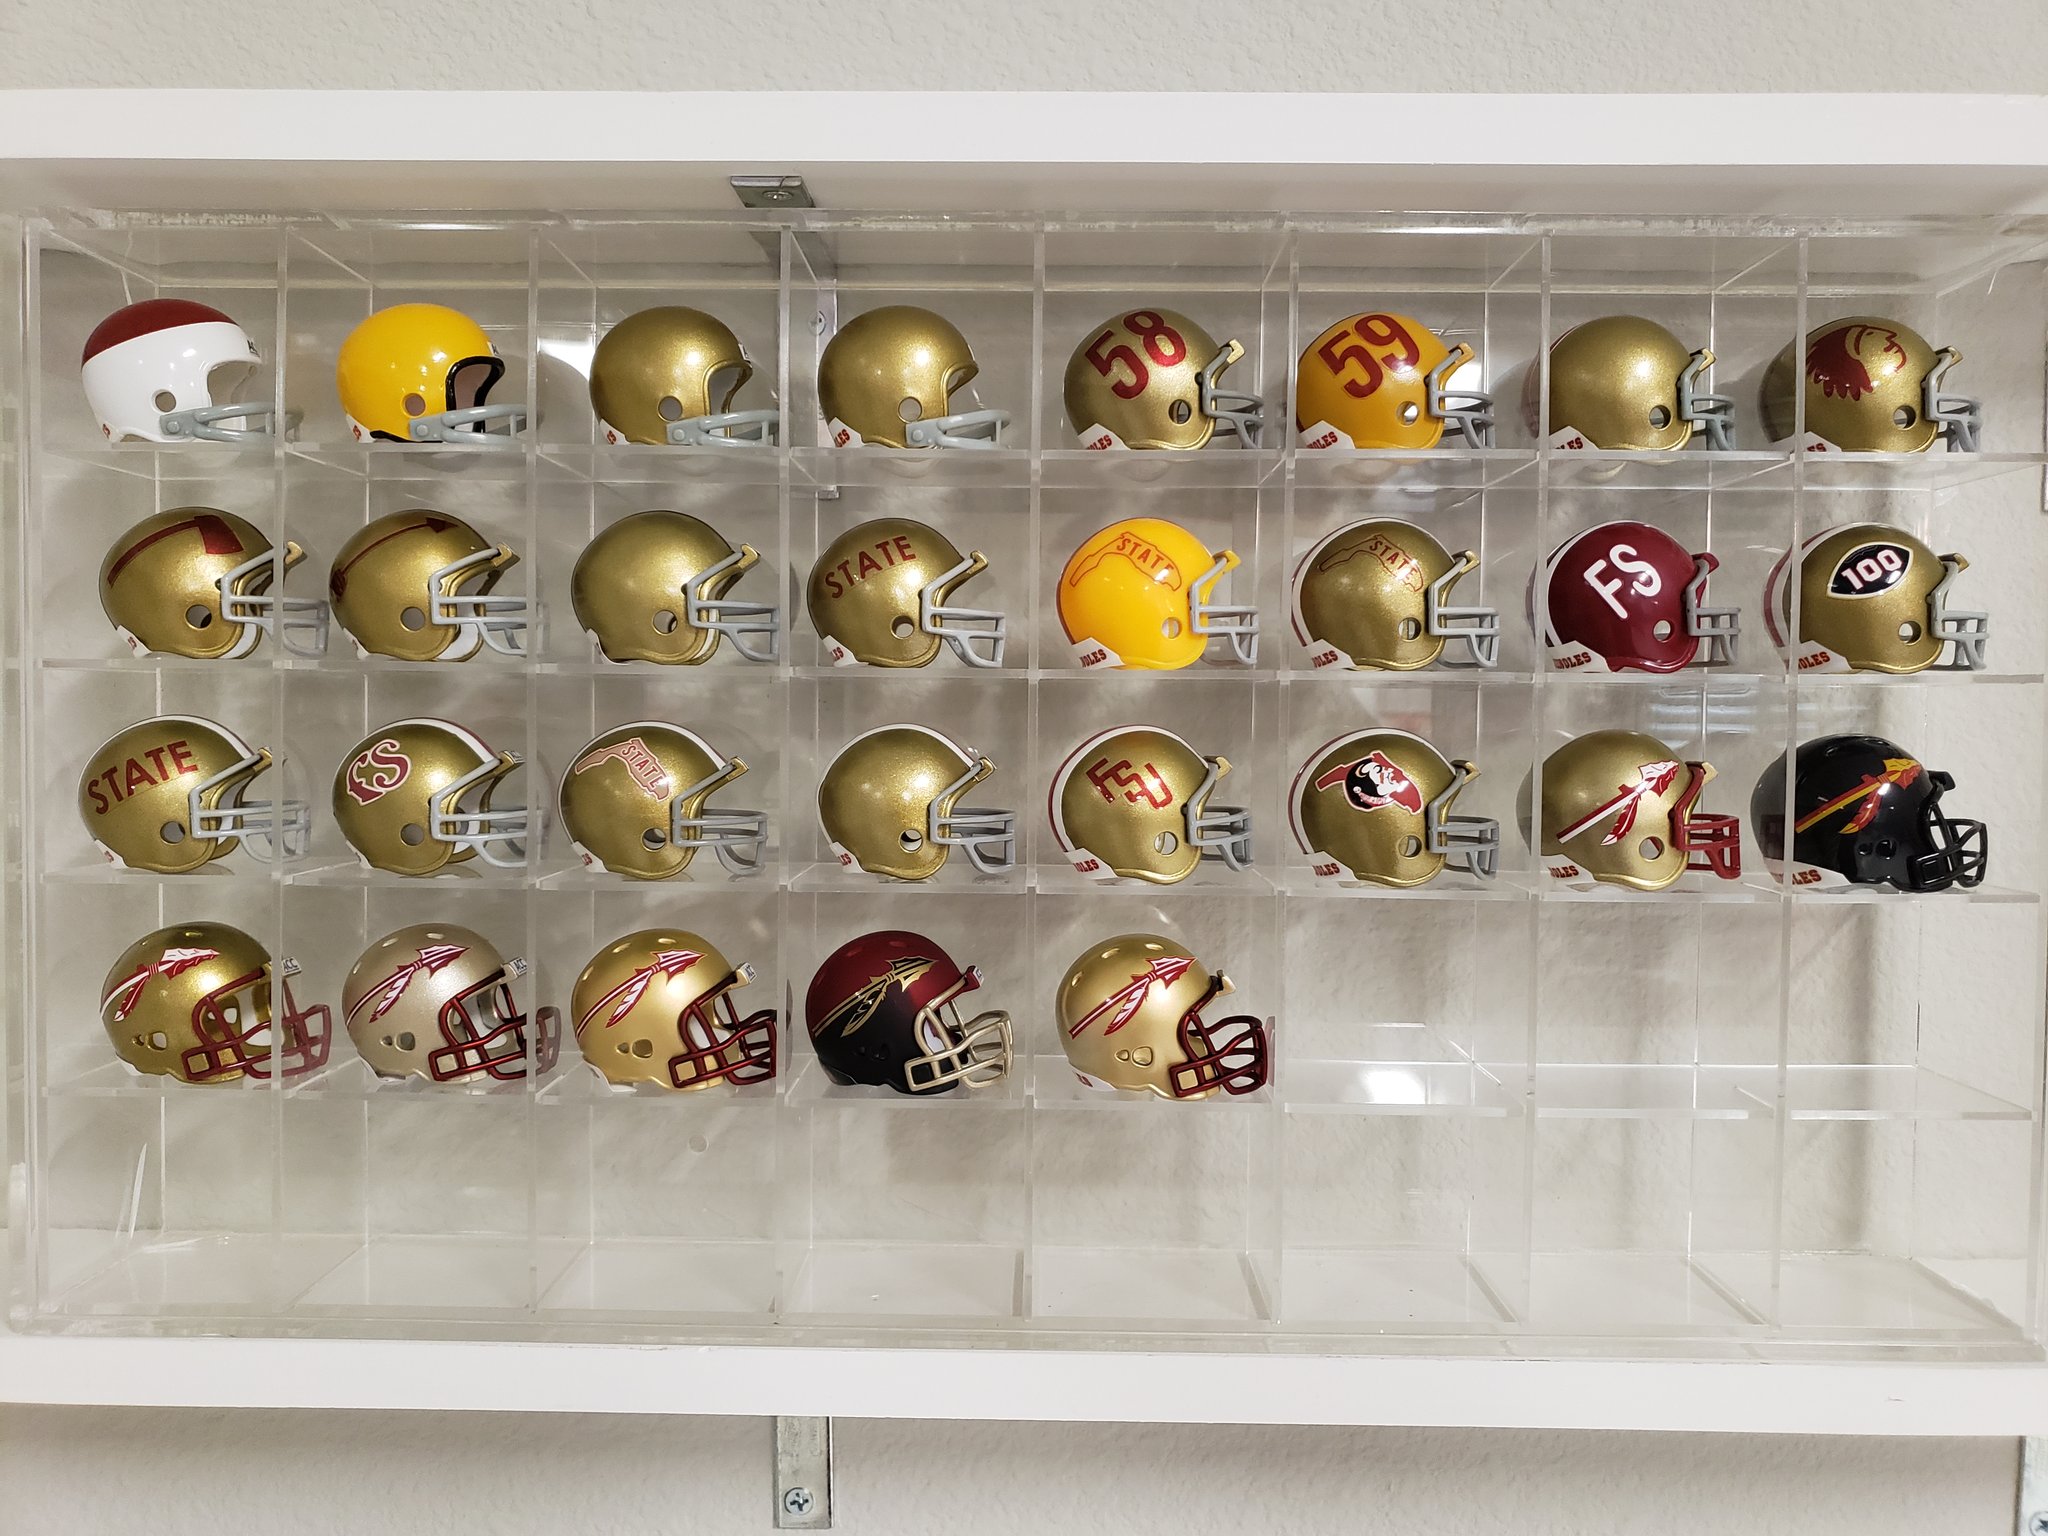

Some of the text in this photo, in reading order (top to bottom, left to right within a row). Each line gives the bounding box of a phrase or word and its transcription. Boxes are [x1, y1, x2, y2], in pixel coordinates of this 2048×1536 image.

[1085, 311, 1187, 399] 58
[1317, 314, 1421, 399] 59
[825, 536, 916, 599] STATE
[1583, 544, 1661, 619] FS
[1841, 549, 1902, 590] 100
[87, 741, 198, 814] STATE
[1085, 758, 1173, 809] FSU
[281, 958, 298, 972] ACC
